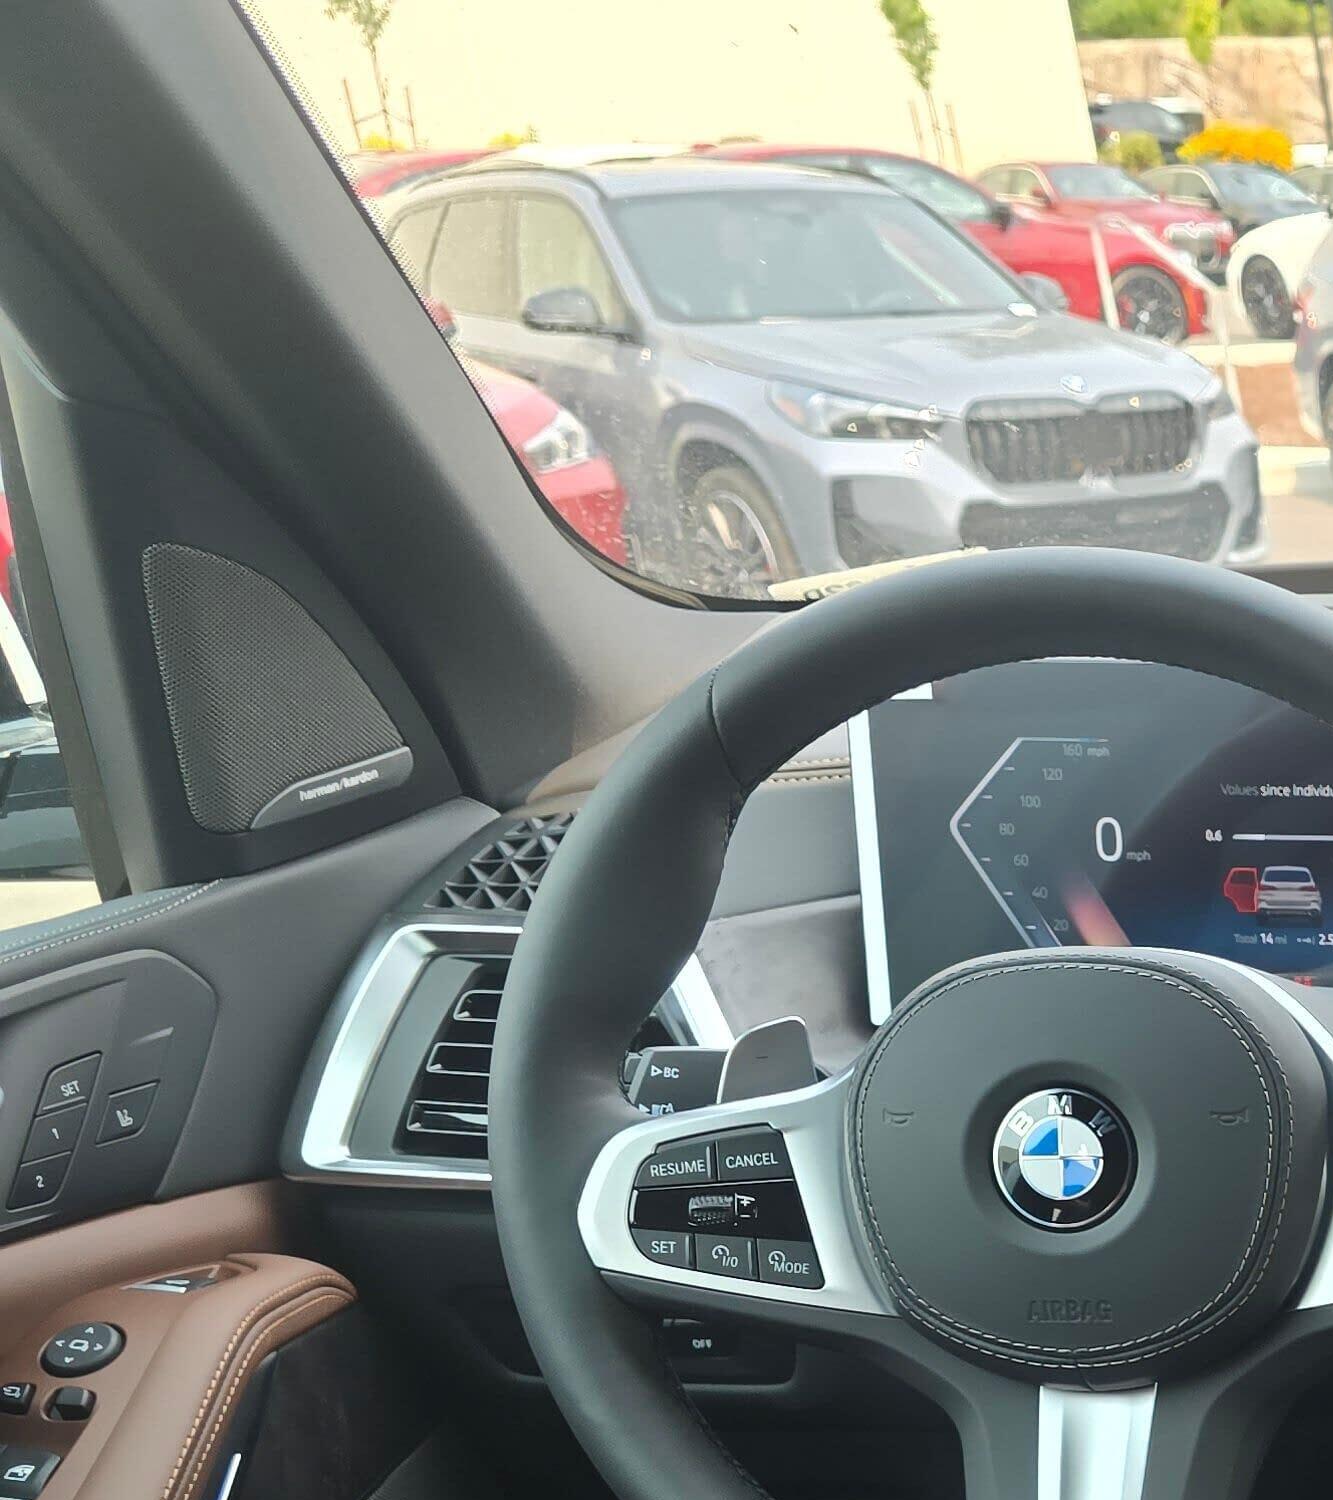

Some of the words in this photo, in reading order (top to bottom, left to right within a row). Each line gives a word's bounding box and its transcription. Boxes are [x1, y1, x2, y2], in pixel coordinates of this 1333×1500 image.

[1062, 743, 1083, 757] 160
[1087, 746, 1110, 758] mph
[1042, 767, 1063, 781] 120
[1220, 784, 1258, 796] Values
[1260, 784, 1291, 798] since
[1020, 795, 1041, 808] 100
[999, 823, 1015, 836] 80
[1205, 828, 1223, 842] 0.6
[1095, 816, 1123, 862] 0
[1013, 854, 1029, 867] 60
[1126, 850, 1151, 862] mph
[1031, 886, 1048, 900] 40
[1053, 918, 1069, 932] 20
[1259, 932, 1274, 945] 14
[663, 1066, 680, 1079] BC
[60, 1080, 81, 1097] SET
[1007, 1094, 1118, 1138] BMW
[725, 1152, 778, 1169] CANCEL
[650, 1160, 706, 1177] RESUME
[35, 1175, 45, 1188] 2
[651, 1241, 676, 1254] SET
[773, 1261, 810, 1275] MODE
[1026, 1298, 1114, 1324] AIRBAG
